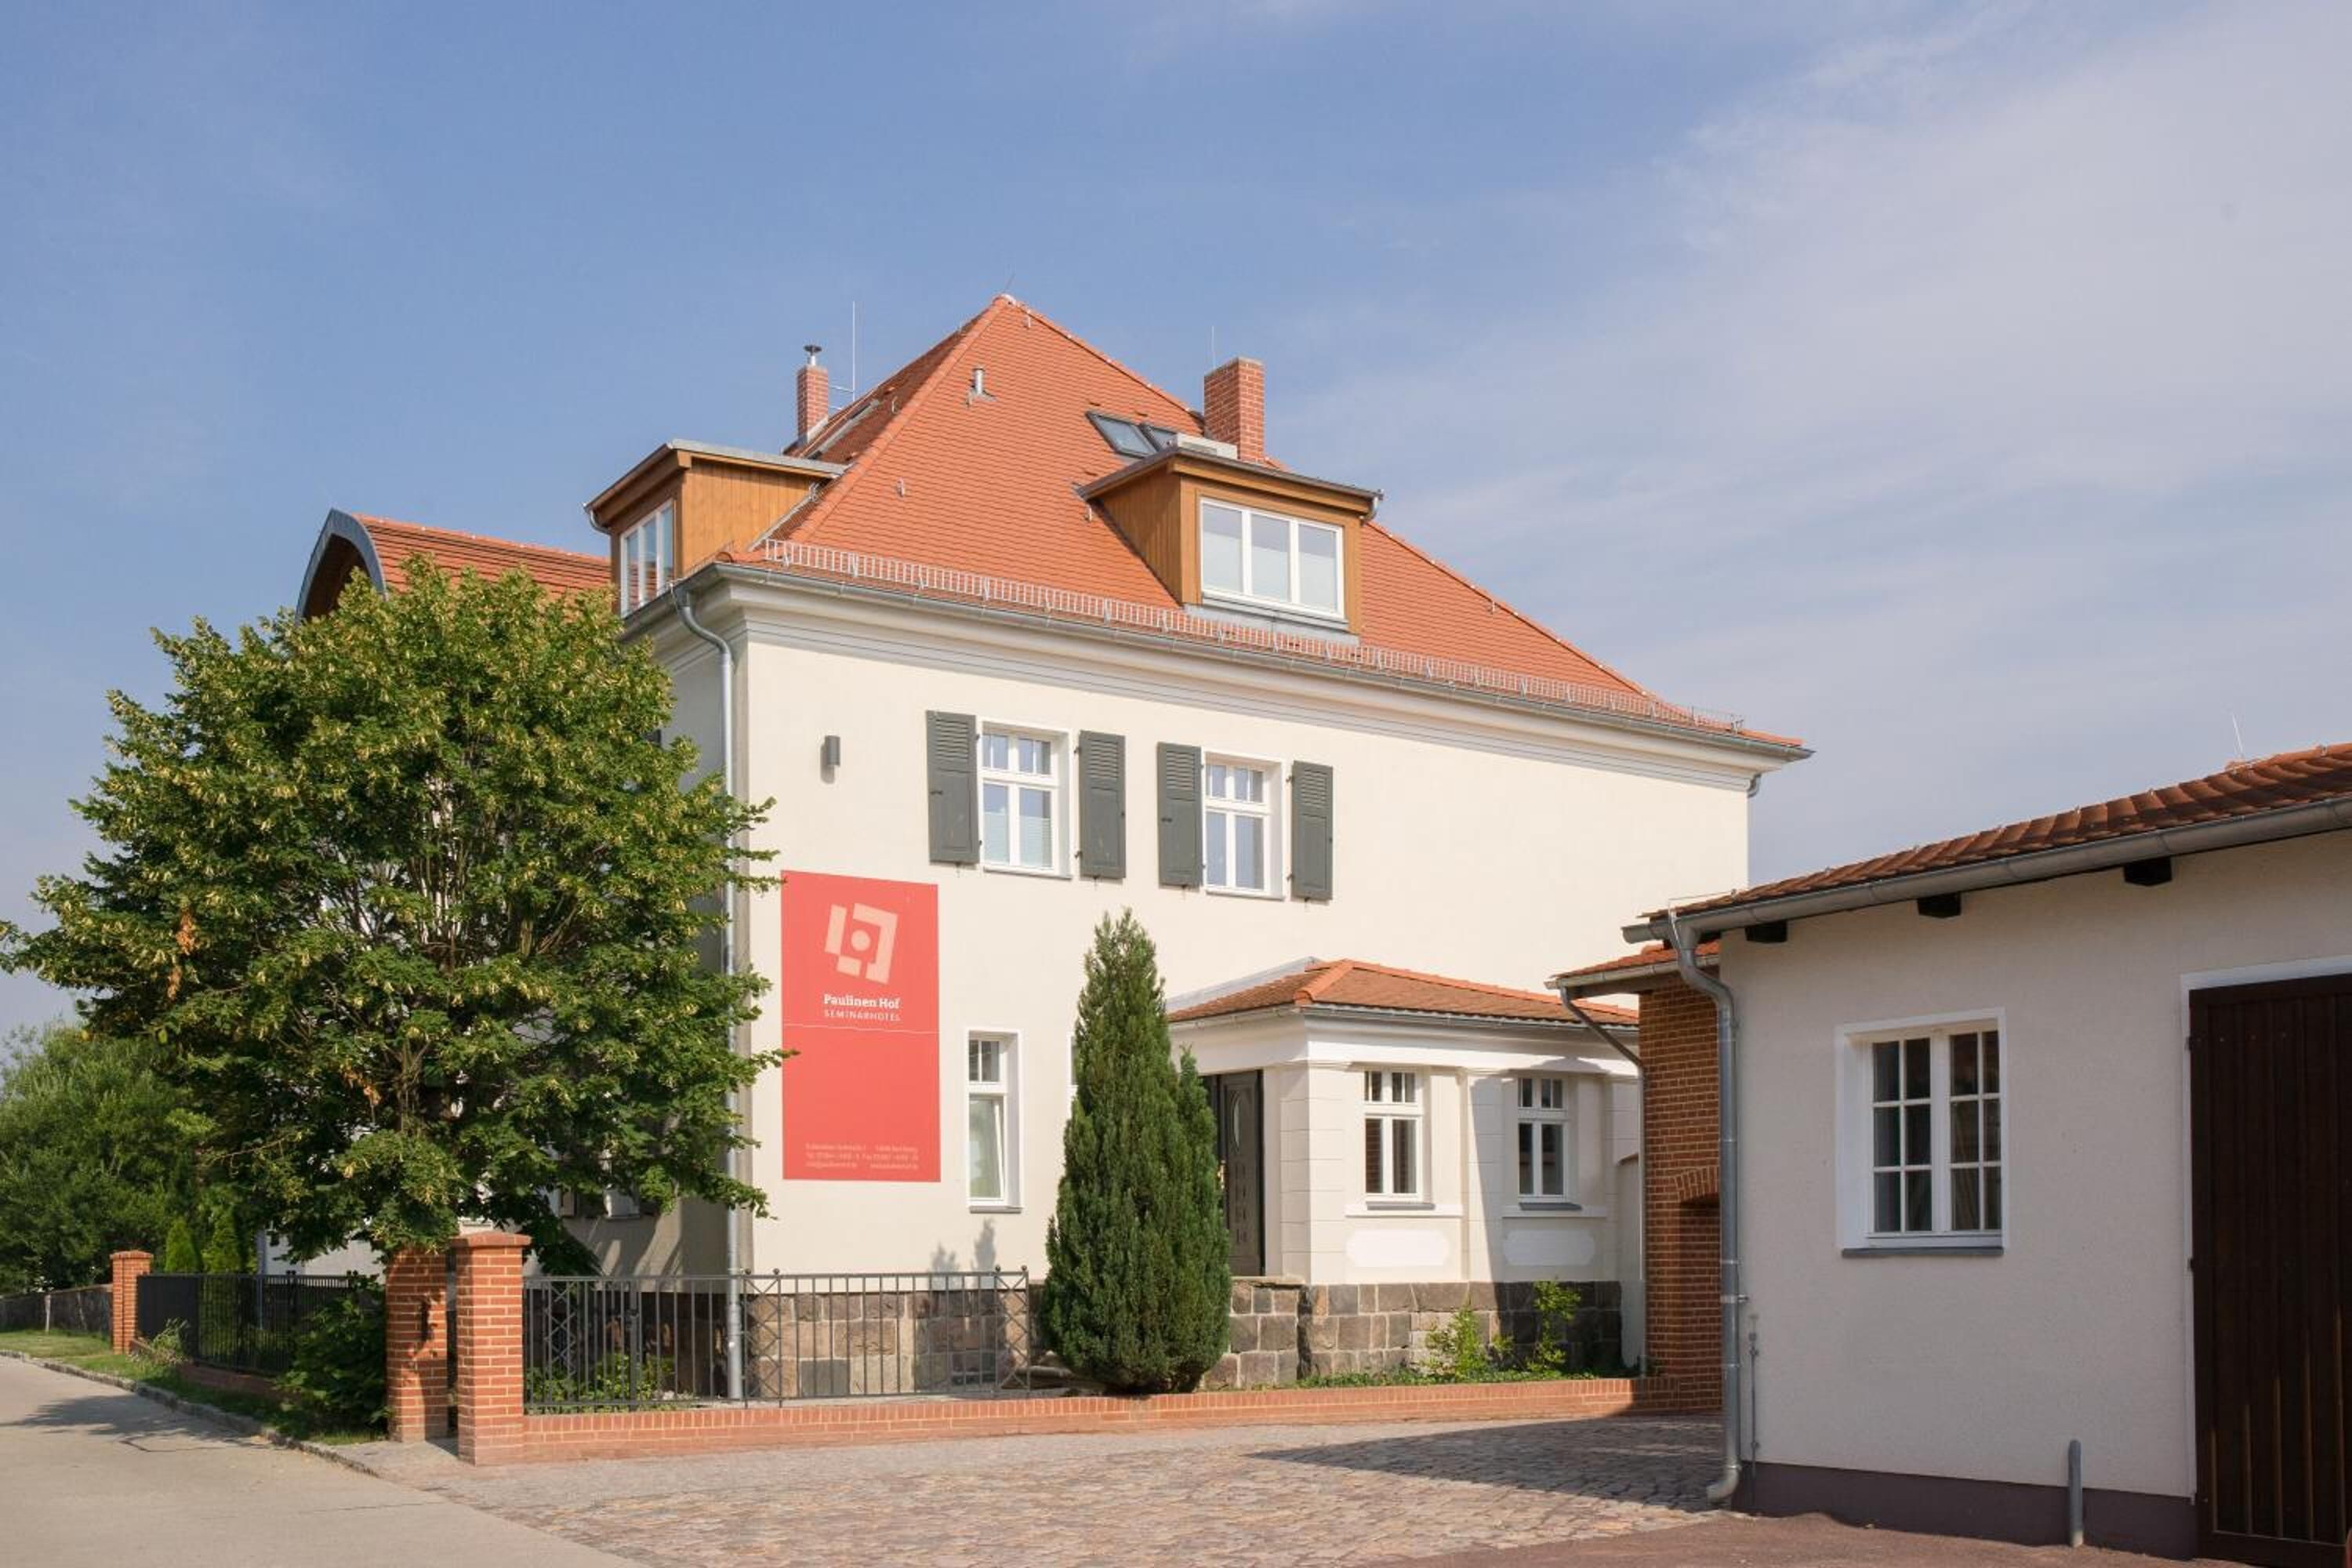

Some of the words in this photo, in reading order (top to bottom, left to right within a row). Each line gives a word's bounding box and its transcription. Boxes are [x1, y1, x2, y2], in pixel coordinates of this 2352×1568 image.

[824, 994, 877, 1007] Paulinen
[879, 997, 900, 1009] Hof
[824, 1010, 901, 1021] SEMINARHOTEL
